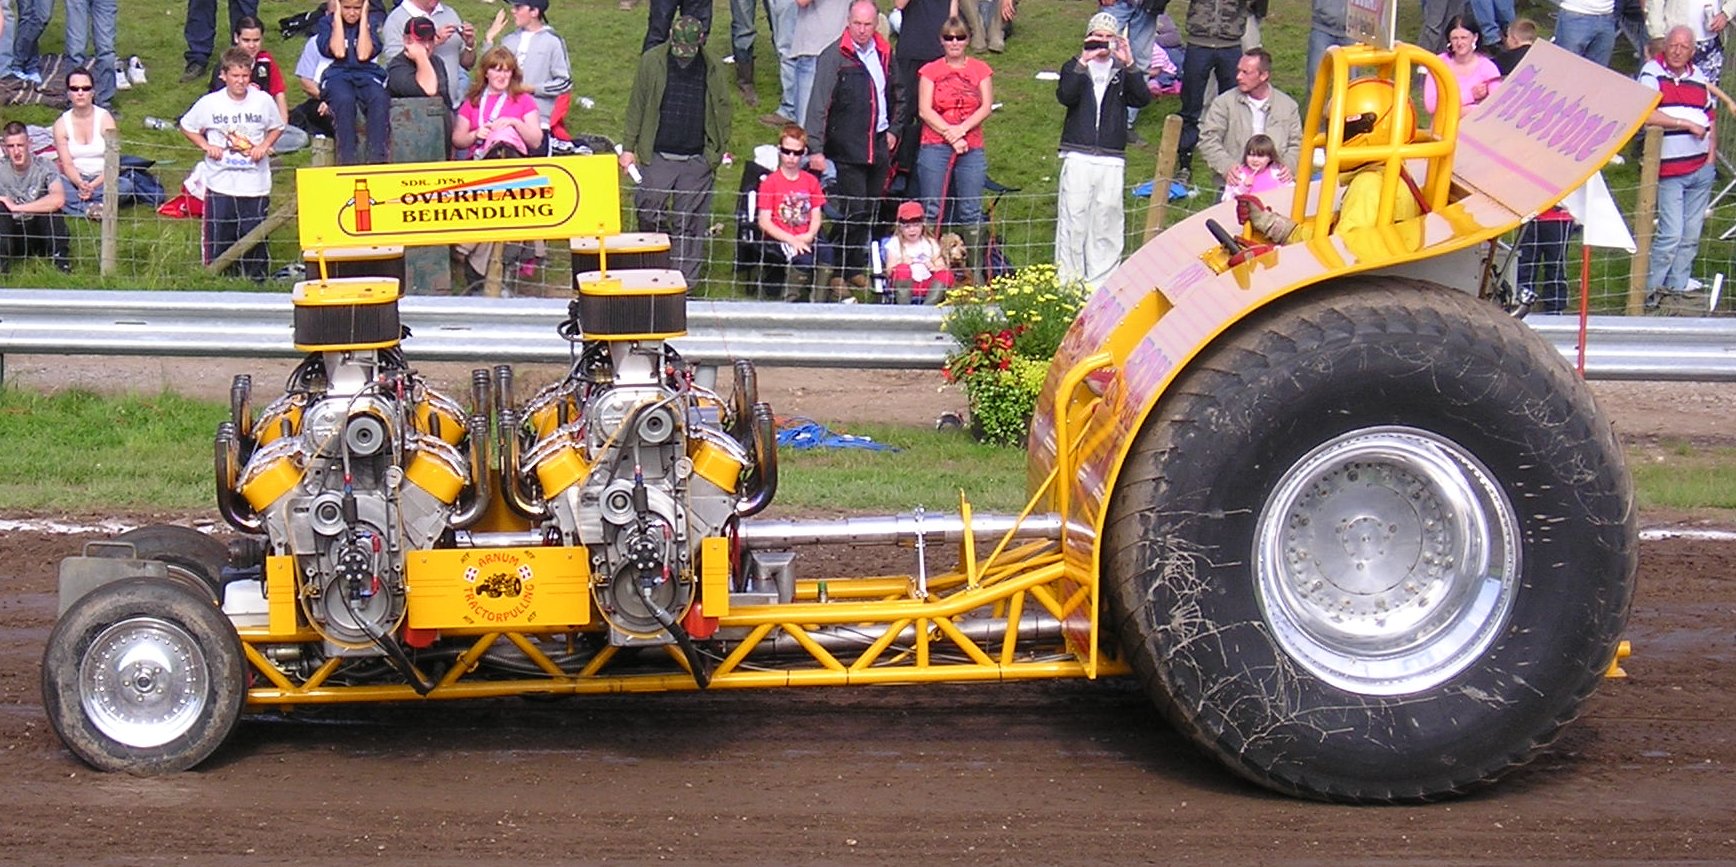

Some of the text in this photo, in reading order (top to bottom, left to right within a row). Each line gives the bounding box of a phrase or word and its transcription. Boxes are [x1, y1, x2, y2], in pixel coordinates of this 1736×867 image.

[212, 113, 229, 124] Isle
[232, 113, 242, 124] of
[1474, 64, 1618, 162] Firestone
[401, 177, 465, 187] SDR. JYSK
[400, 186, 554, 205] OVERFLADE
[402, 203, 554, 223] BEHANDLING
[478, 552, 519, 567] ARNUM
[464, 584, 535, 622] TRACTORPULLING
